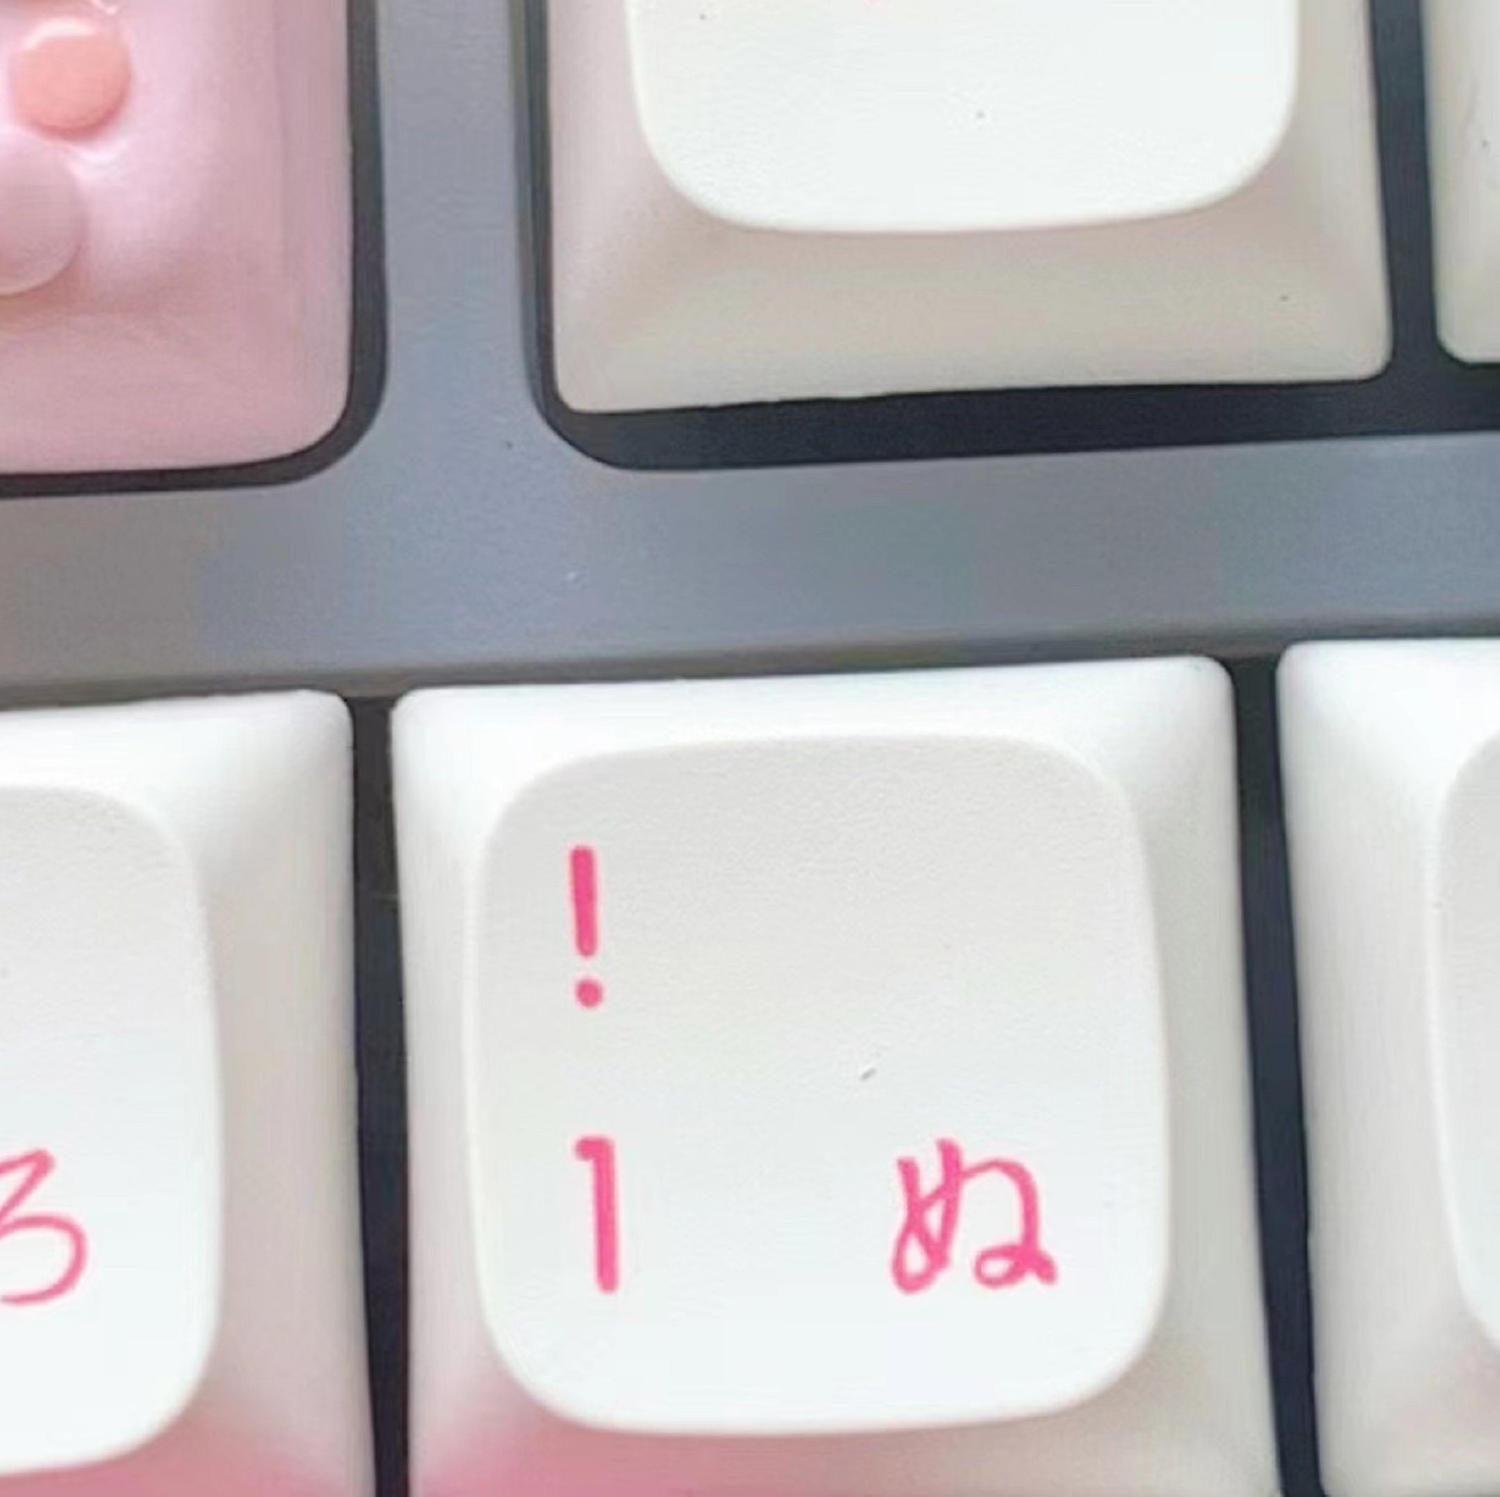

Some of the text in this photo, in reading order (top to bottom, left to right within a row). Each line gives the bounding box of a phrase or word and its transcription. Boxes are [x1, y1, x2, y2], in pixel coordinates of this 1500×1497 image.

[567, 844, 604, 1009] !
[573, 1134, 621, 1295] 1
[889, 1136, 1059, 1296] ぬ
